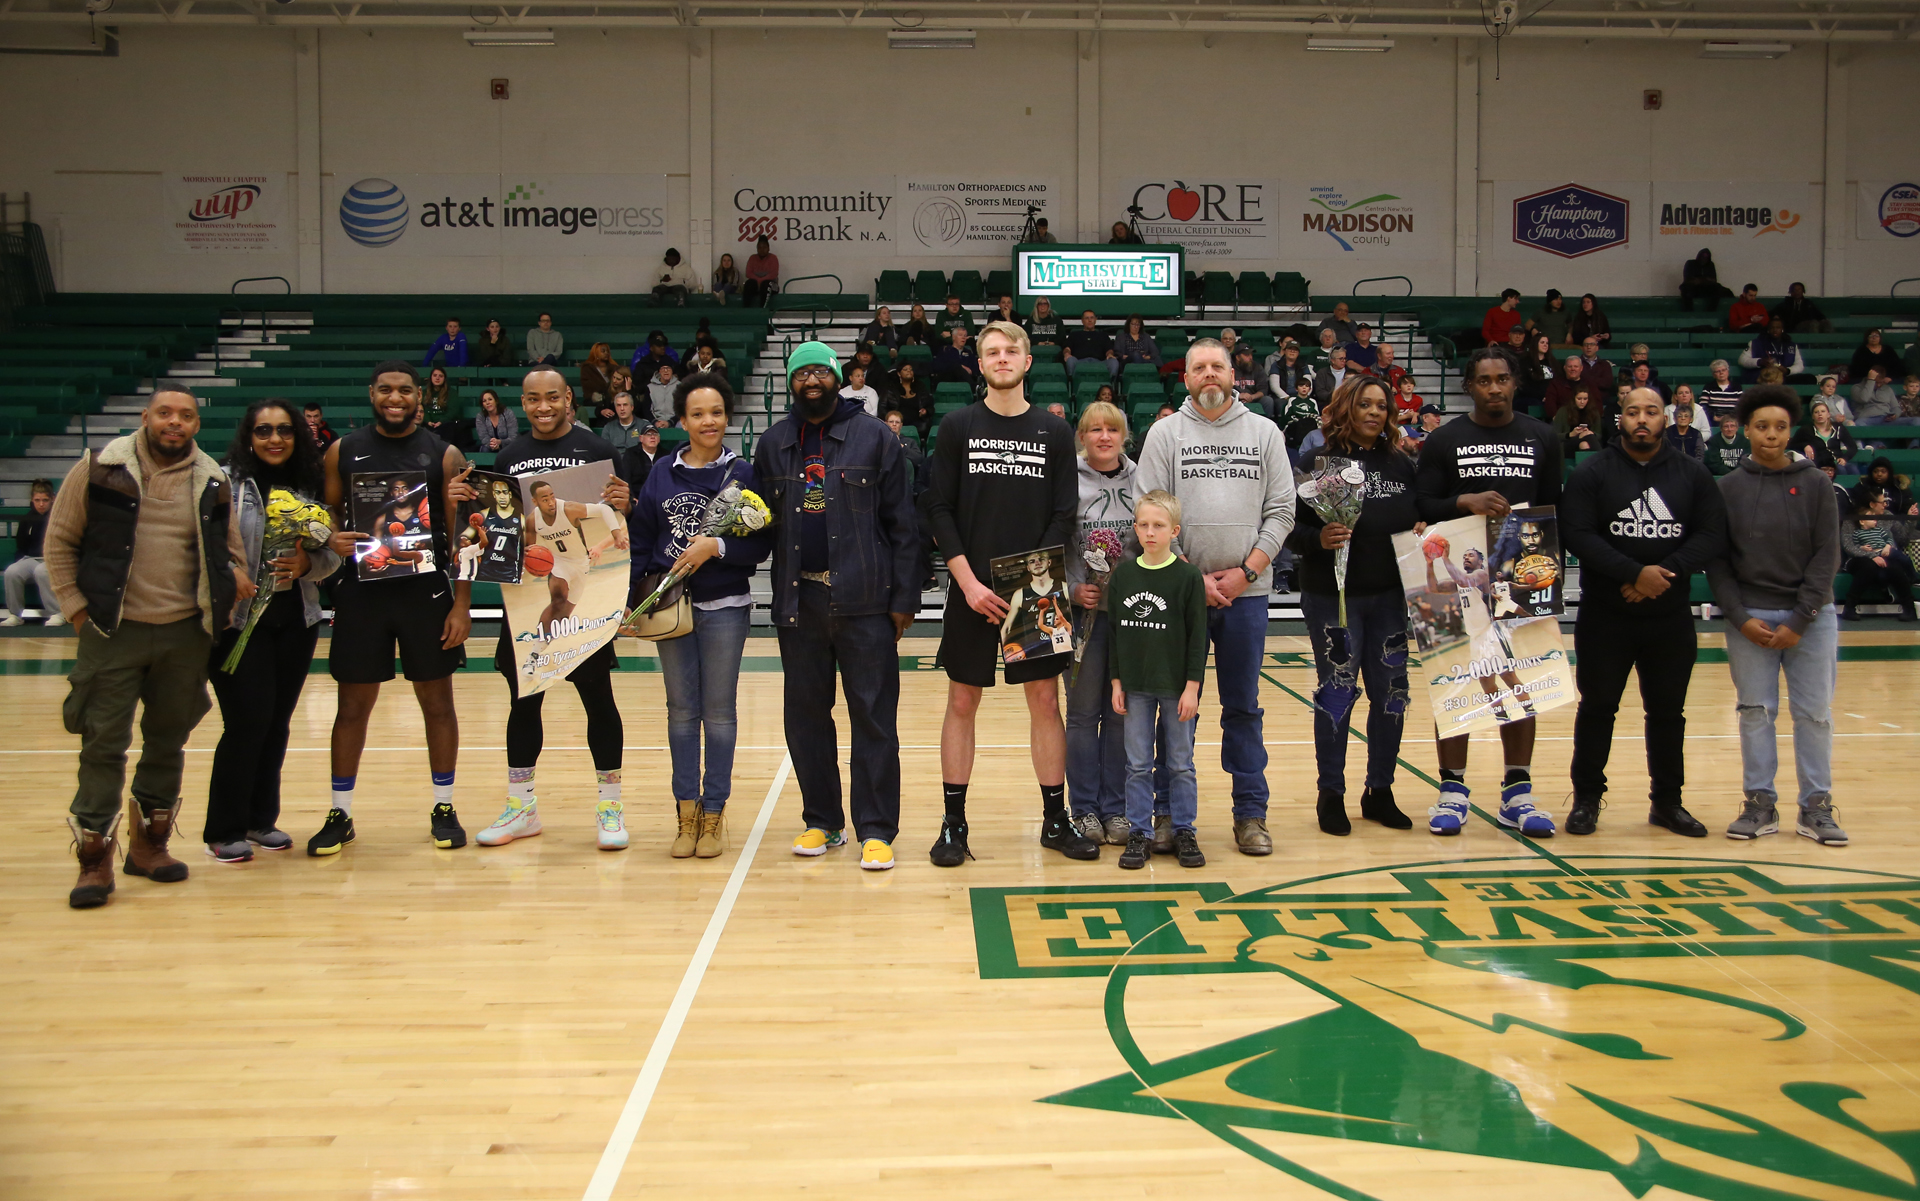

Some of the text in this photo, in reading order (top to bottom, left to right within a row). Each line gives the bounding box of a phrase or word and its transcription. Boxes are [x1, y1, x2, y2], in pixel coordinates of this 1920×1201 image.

[908, 183, 1047, 192] HAMILTON ORTHOPAEDICS AND
[1892, 190, 1918, 199] CSEA
[195, 190, 254, 219] uup
[734, 188, 892, 220] Community
[965, 198, 1047, 207] SPORTS MEDICINE
[420, 197, 495, 228] at&t
[1531, 204, 1608, 224] Hampton
[1660, 204, 1772, 228] Advantage
[784, 216, 892, 241] Bank N.A.
[1146, 226, 1251, 234] FEDERAL CREDIT UNION
[1303, 213, 1413, 232] MADISON
[1660, 227, 1681, 235] Sport
[1690, 226, 1718, 235] Fitness
[1720, 227, 1734, 235] Inc.
[1527, 223, 1616, 240] Inn & Suites
[1170, 240, 1227, 248] www.core-fcu.com
[1353, 234, 1390, 246] county
[1034, 262, 1164, 283] MORRISVILLE
[1087, 279, 1118, 287] STATE
[968, 438, 1046, 454] MORRISVILLE
[1181, 445, 1259, 456] MORRISVILLE
[1456, 444, 1534, 456] MORRISVILLE
[509, 457, 586, 474] MORRISVILLE
[968, 462, 1044, 478] BASKETBALL
[1458, 466, 1532, 478] BASKETBALL
[1181, 468, 1259, 480] BASKETBALL
[1082, 519, 1133, 529] MORRISV
[1609, 519, 1682, 538] adidas
[494, 535, 507, 551] 0
[555, 540, 567, 552] 0
[490, 552, 506, 562] State
[1123, 591, 1167, 611] Morrisville
[1529, 585, 1553, 604] 30
[1535, 607, 1552, 616] State
[536, 616, 580, 642] 1,000
[1120, 619, 1167, 629] Mustangs
[536, 654, 550, 668] #0
[553, 648, 577, 665] Tyrin
[1451, 655, 1504, 685] 2,000
[1444, 676, 1560, 711] #30 Kevin Dennis
[1487, 704, 1502, 713] 2020
[1461, 878, 1748, 901] STATE
